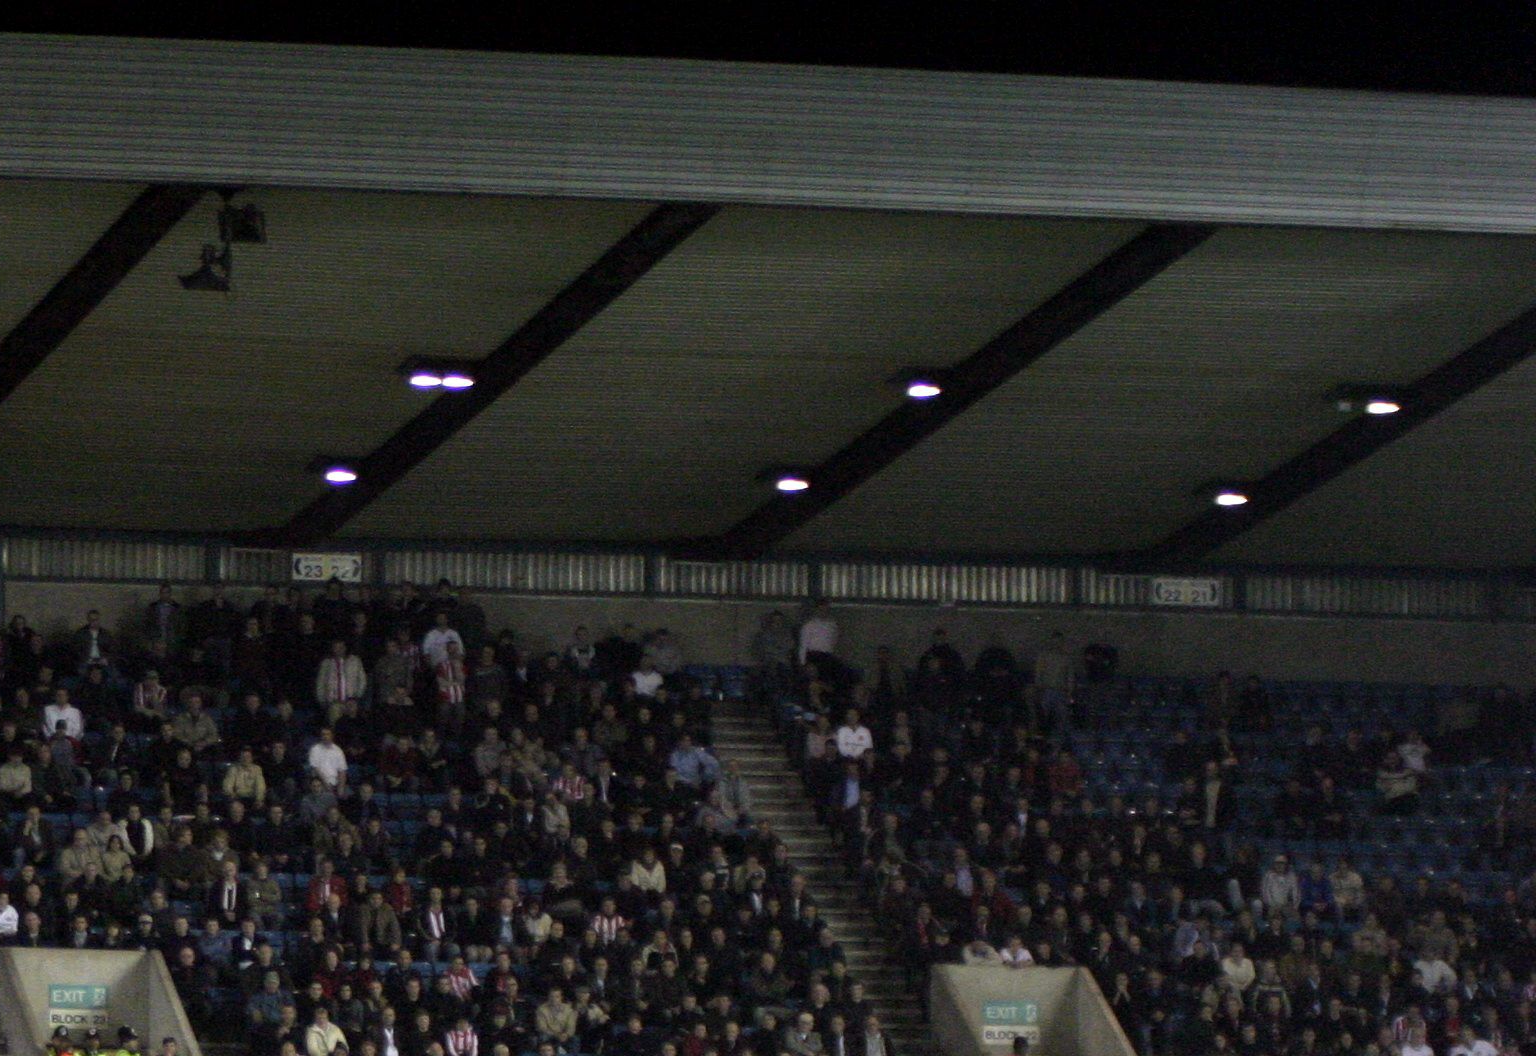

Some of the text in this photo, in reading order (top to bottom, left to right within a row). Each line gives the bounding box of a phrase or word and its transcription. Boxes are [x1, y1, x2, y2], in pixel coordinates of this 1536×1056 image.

[53, 990, 85, 1002] EXIT
[52, 1014, 87, 1024] BLOCK
[986, 1007, 1018, 1019] EXIT
